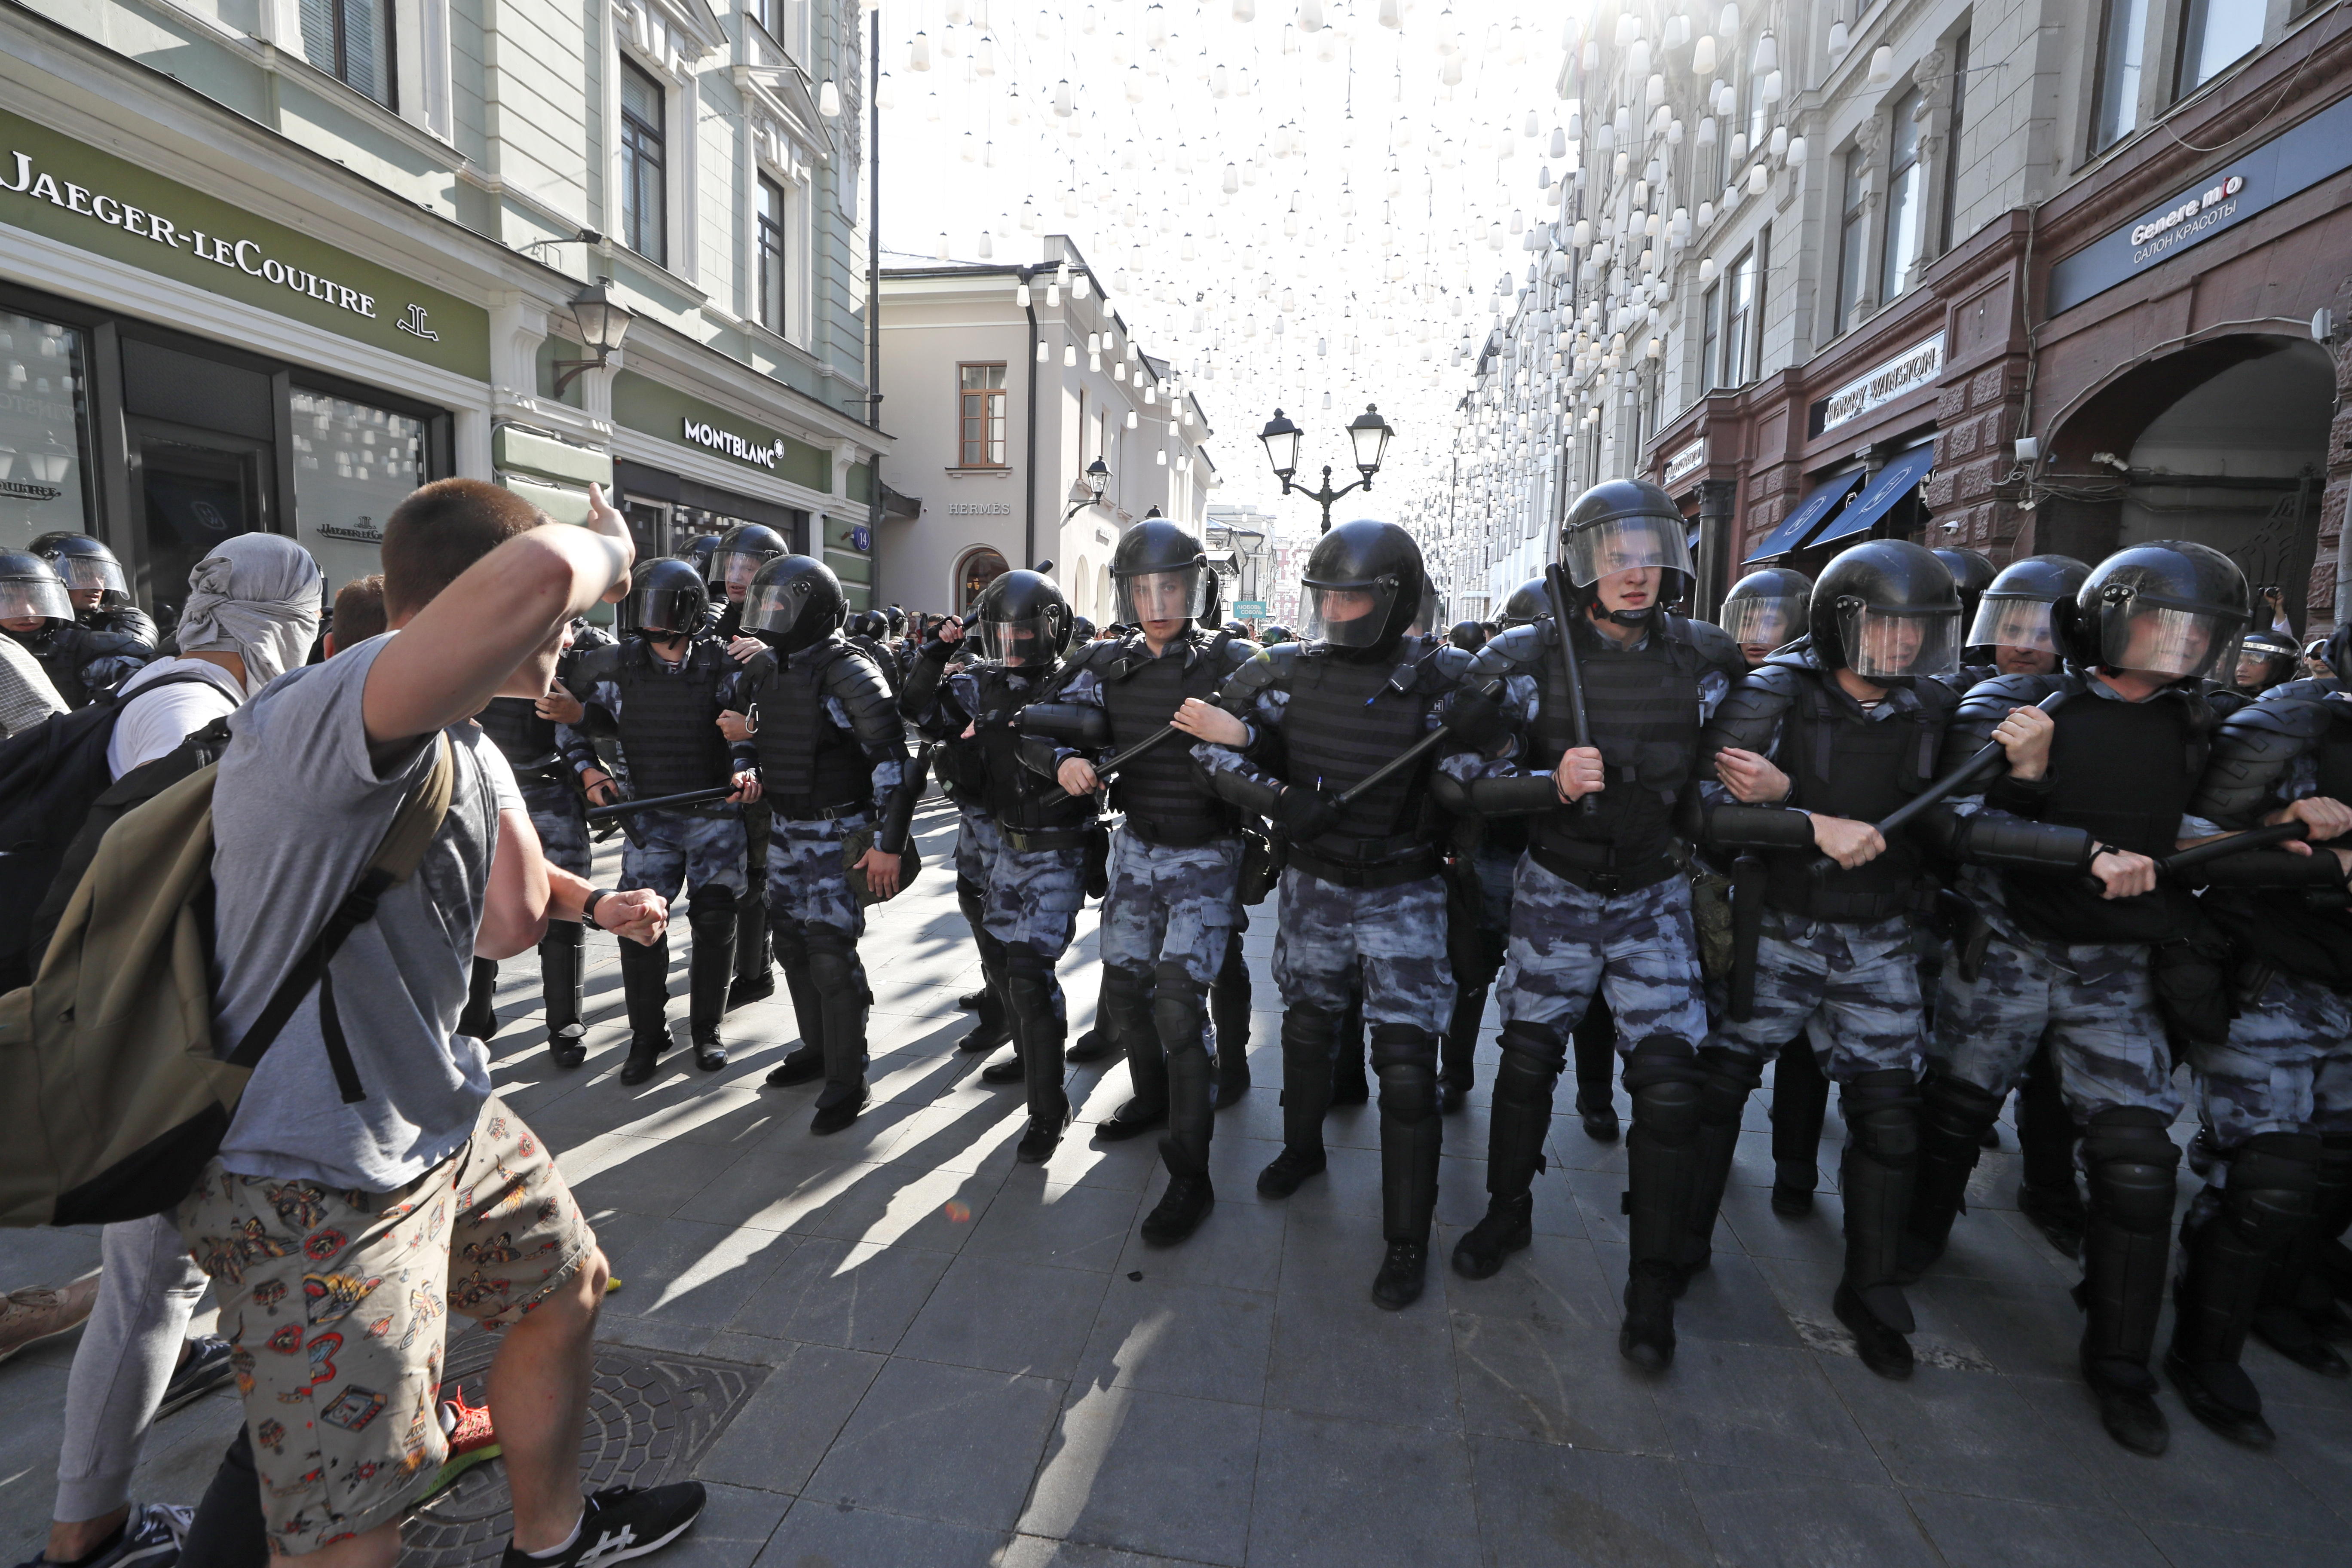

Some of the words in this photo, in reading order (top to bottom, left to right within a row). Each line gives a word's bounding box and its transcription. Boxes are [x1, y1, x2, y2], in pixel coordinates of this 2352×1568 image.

[2131, 199, 2200, 246] Genere
[2202, 176, 2243, 208] mio
[2134, 233, 2173, 264] САЛОН
[2175, 199, 2237, 242] КРАСОТЫ
[1825, 385, 1868, 423] HARRY
[1870, 347, 1936, 399] WINSTON
[683, 416, 774, 469] MONTBLANC
[860, 532, 867, 545] 14
